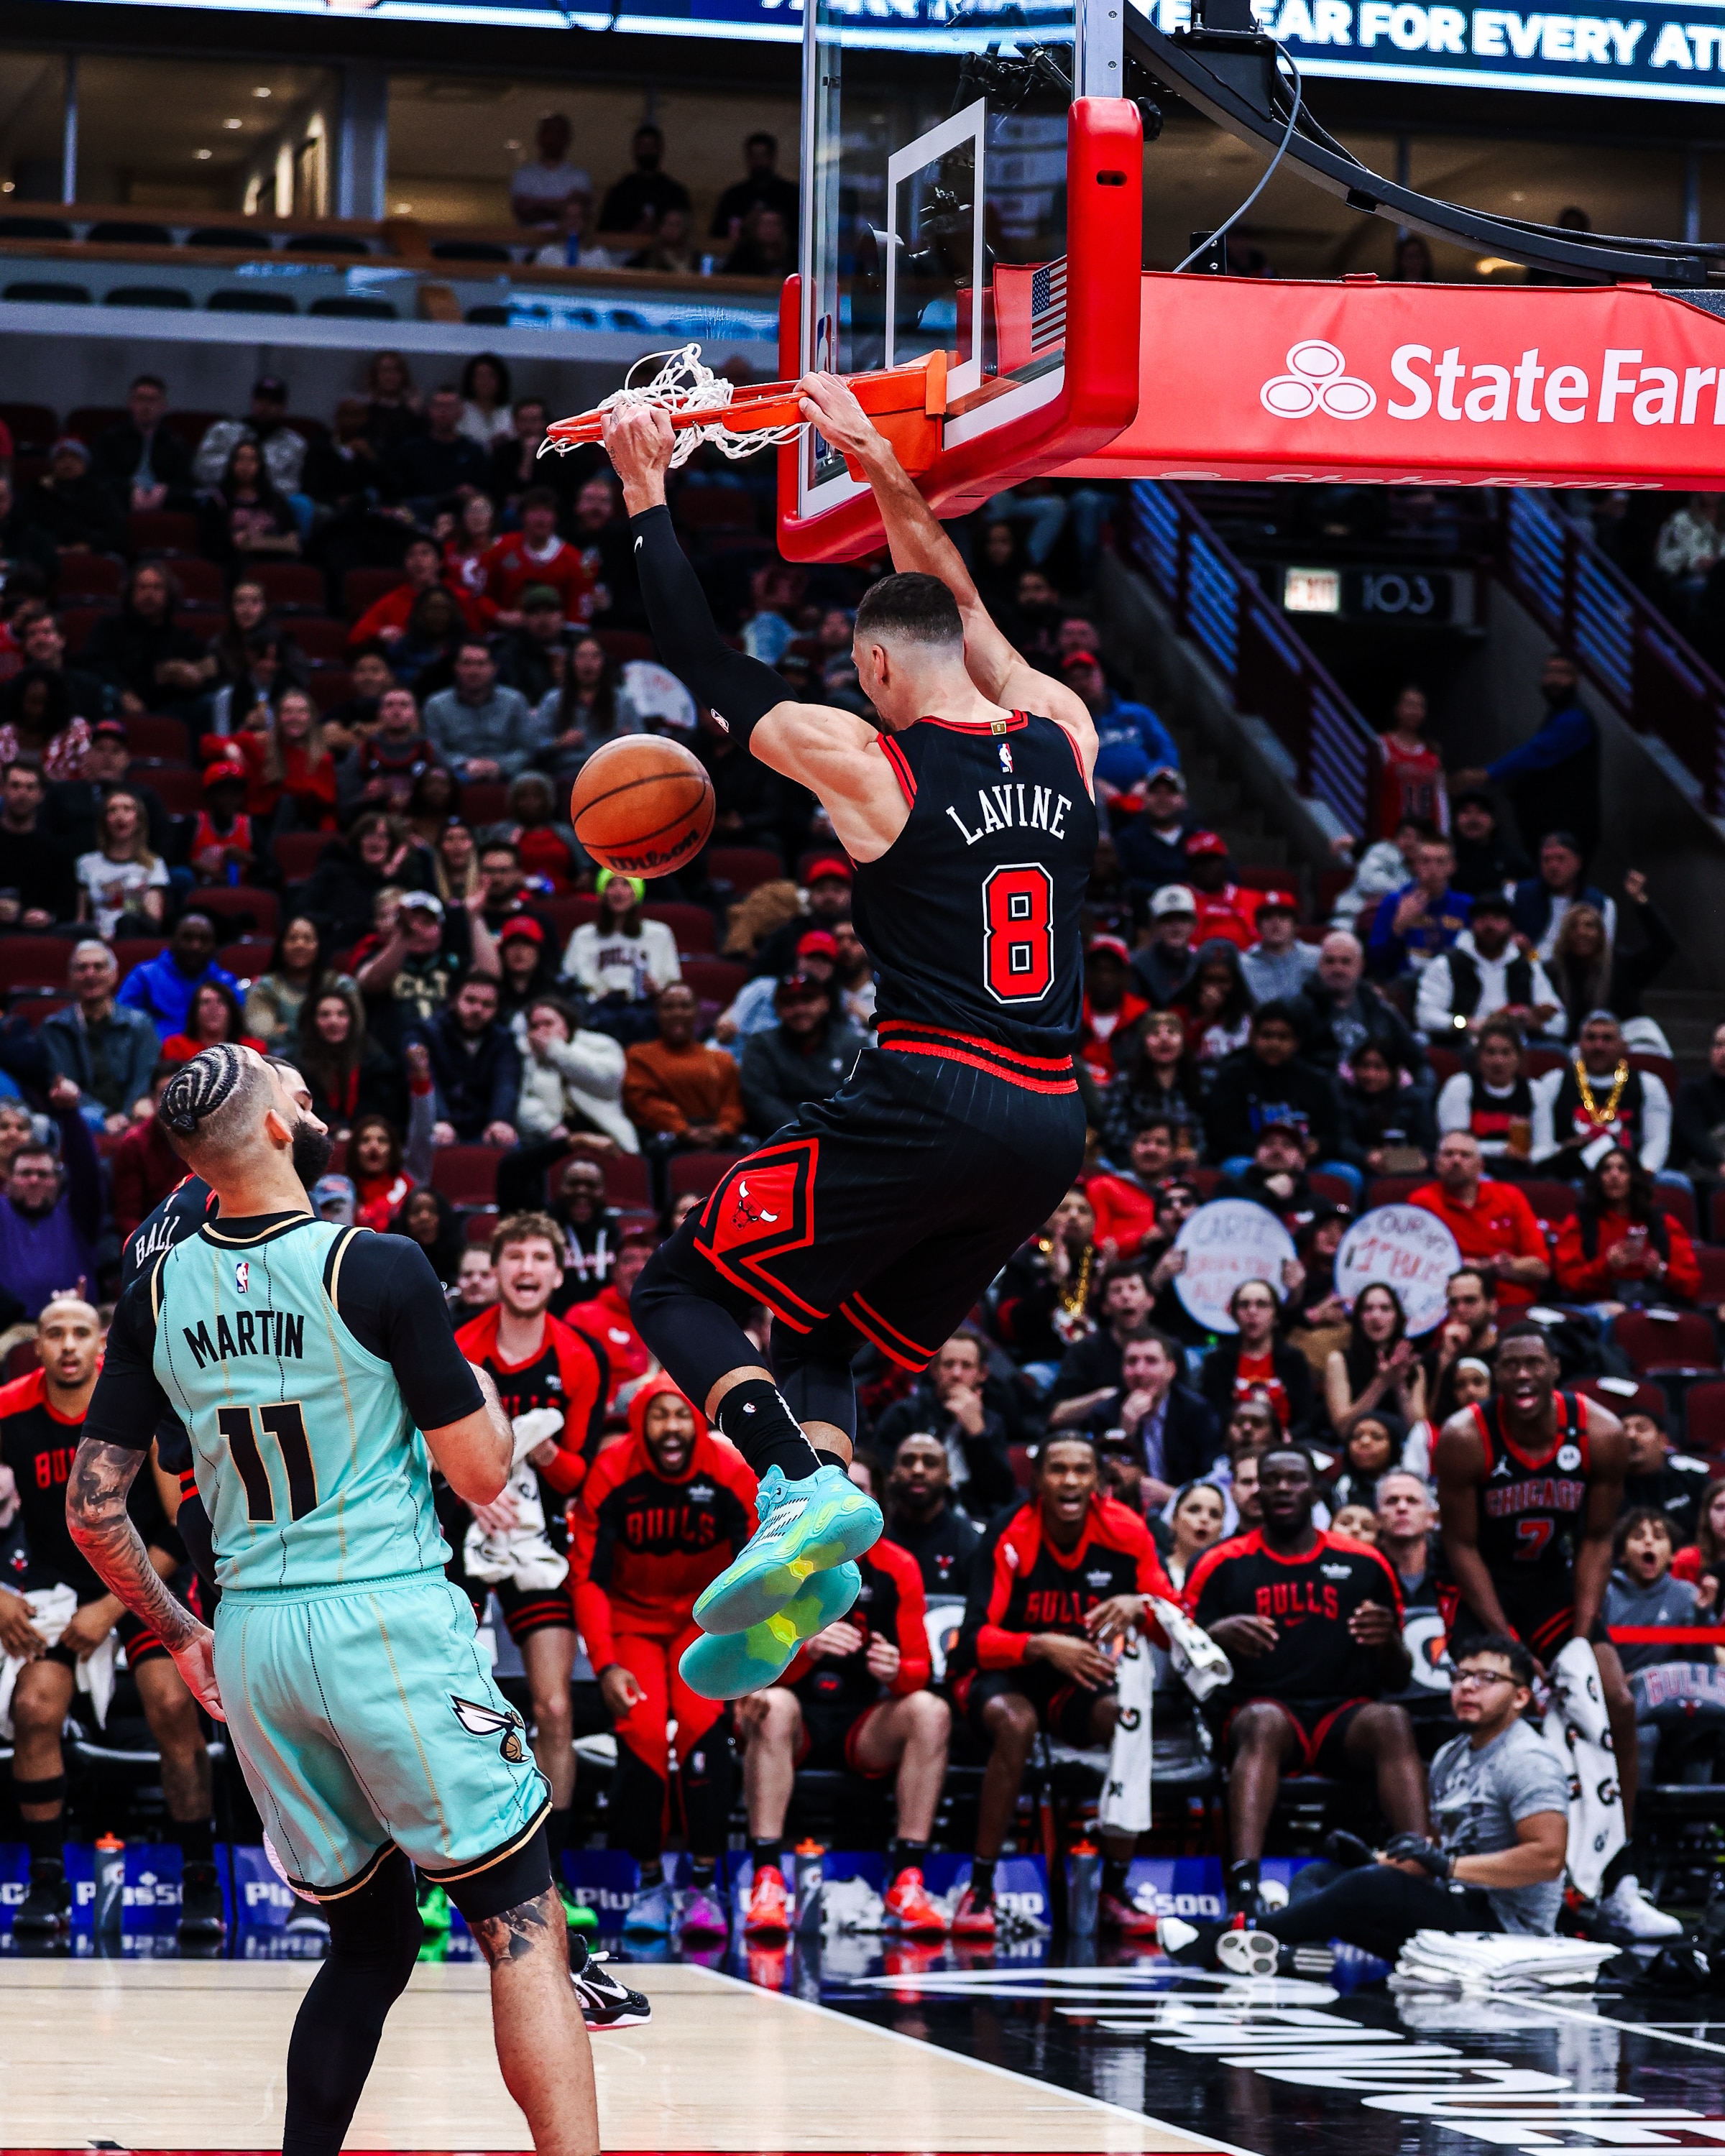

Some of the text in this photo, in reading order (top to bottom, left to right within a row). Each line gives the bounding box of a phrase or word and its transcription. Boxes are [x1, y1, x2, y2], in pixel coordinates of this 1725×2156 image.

[1356, 1, 1468, 54] FOR
[1472, 8, 1647, 65] EVERY
[1649, 22, 1725, 72] AT
[1597, 349, 1725, 426] Far
[1363, 574, 1434, 614] 103
[946, 784, 1072, 845] LAVINE
[605, 829, 700, 871] Wilson
[982, 862, 1054, 1004] 8
[135, 1216, 180, 1268] BALL
[182, 1310, 305, 1369] MARTIN
[216, 1401, 318, 1524] 11
[627, 1505, 716, 1546] BULLS
[1514, 1517, 1555, 1561] 7
[1255, 1580, 1339, 1621] BULLS
